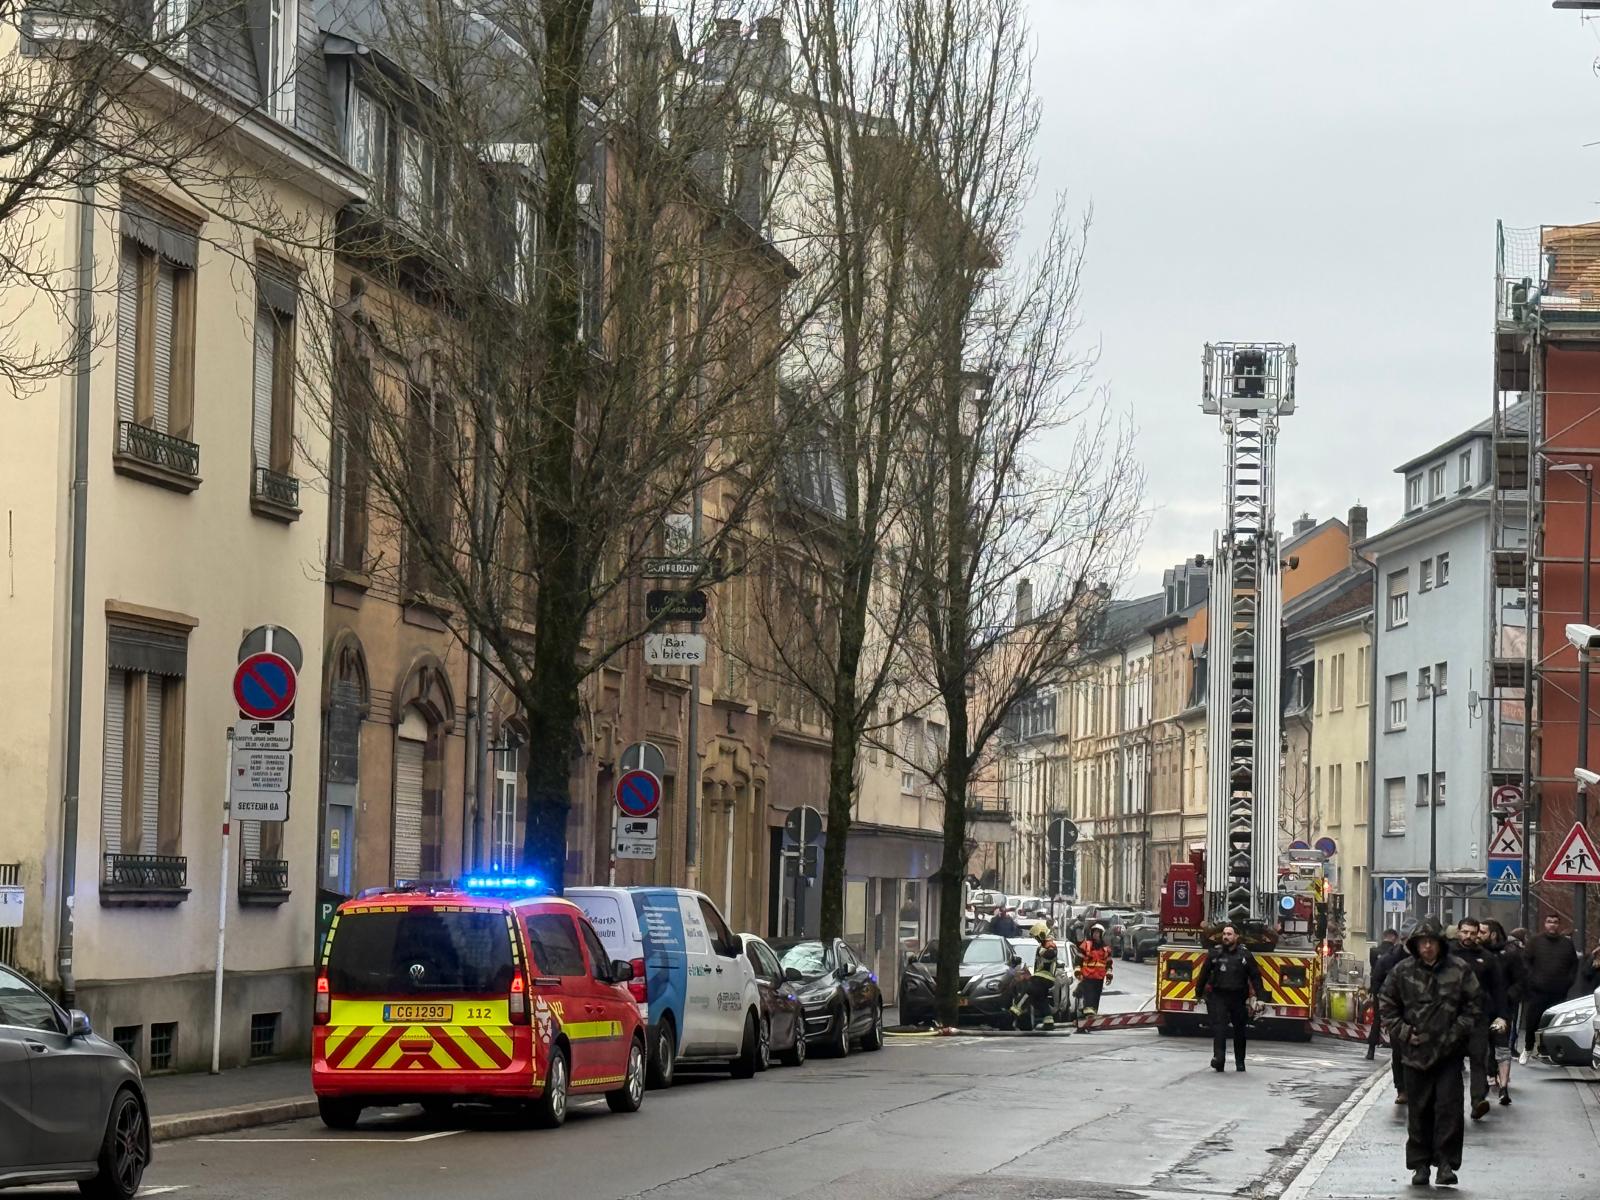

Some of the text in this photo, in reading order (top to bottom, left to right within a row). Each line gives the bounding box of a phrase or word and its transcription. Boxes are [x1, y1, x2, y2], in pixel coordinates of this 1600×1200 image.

[665, 638, 687, 648] Bar
[651, 647, 700, 660] à bières
[238, 801, 268, 811] SECTEUR
[322, 903, 333, 920] P
[466, 1007, 492, 1019] 112
